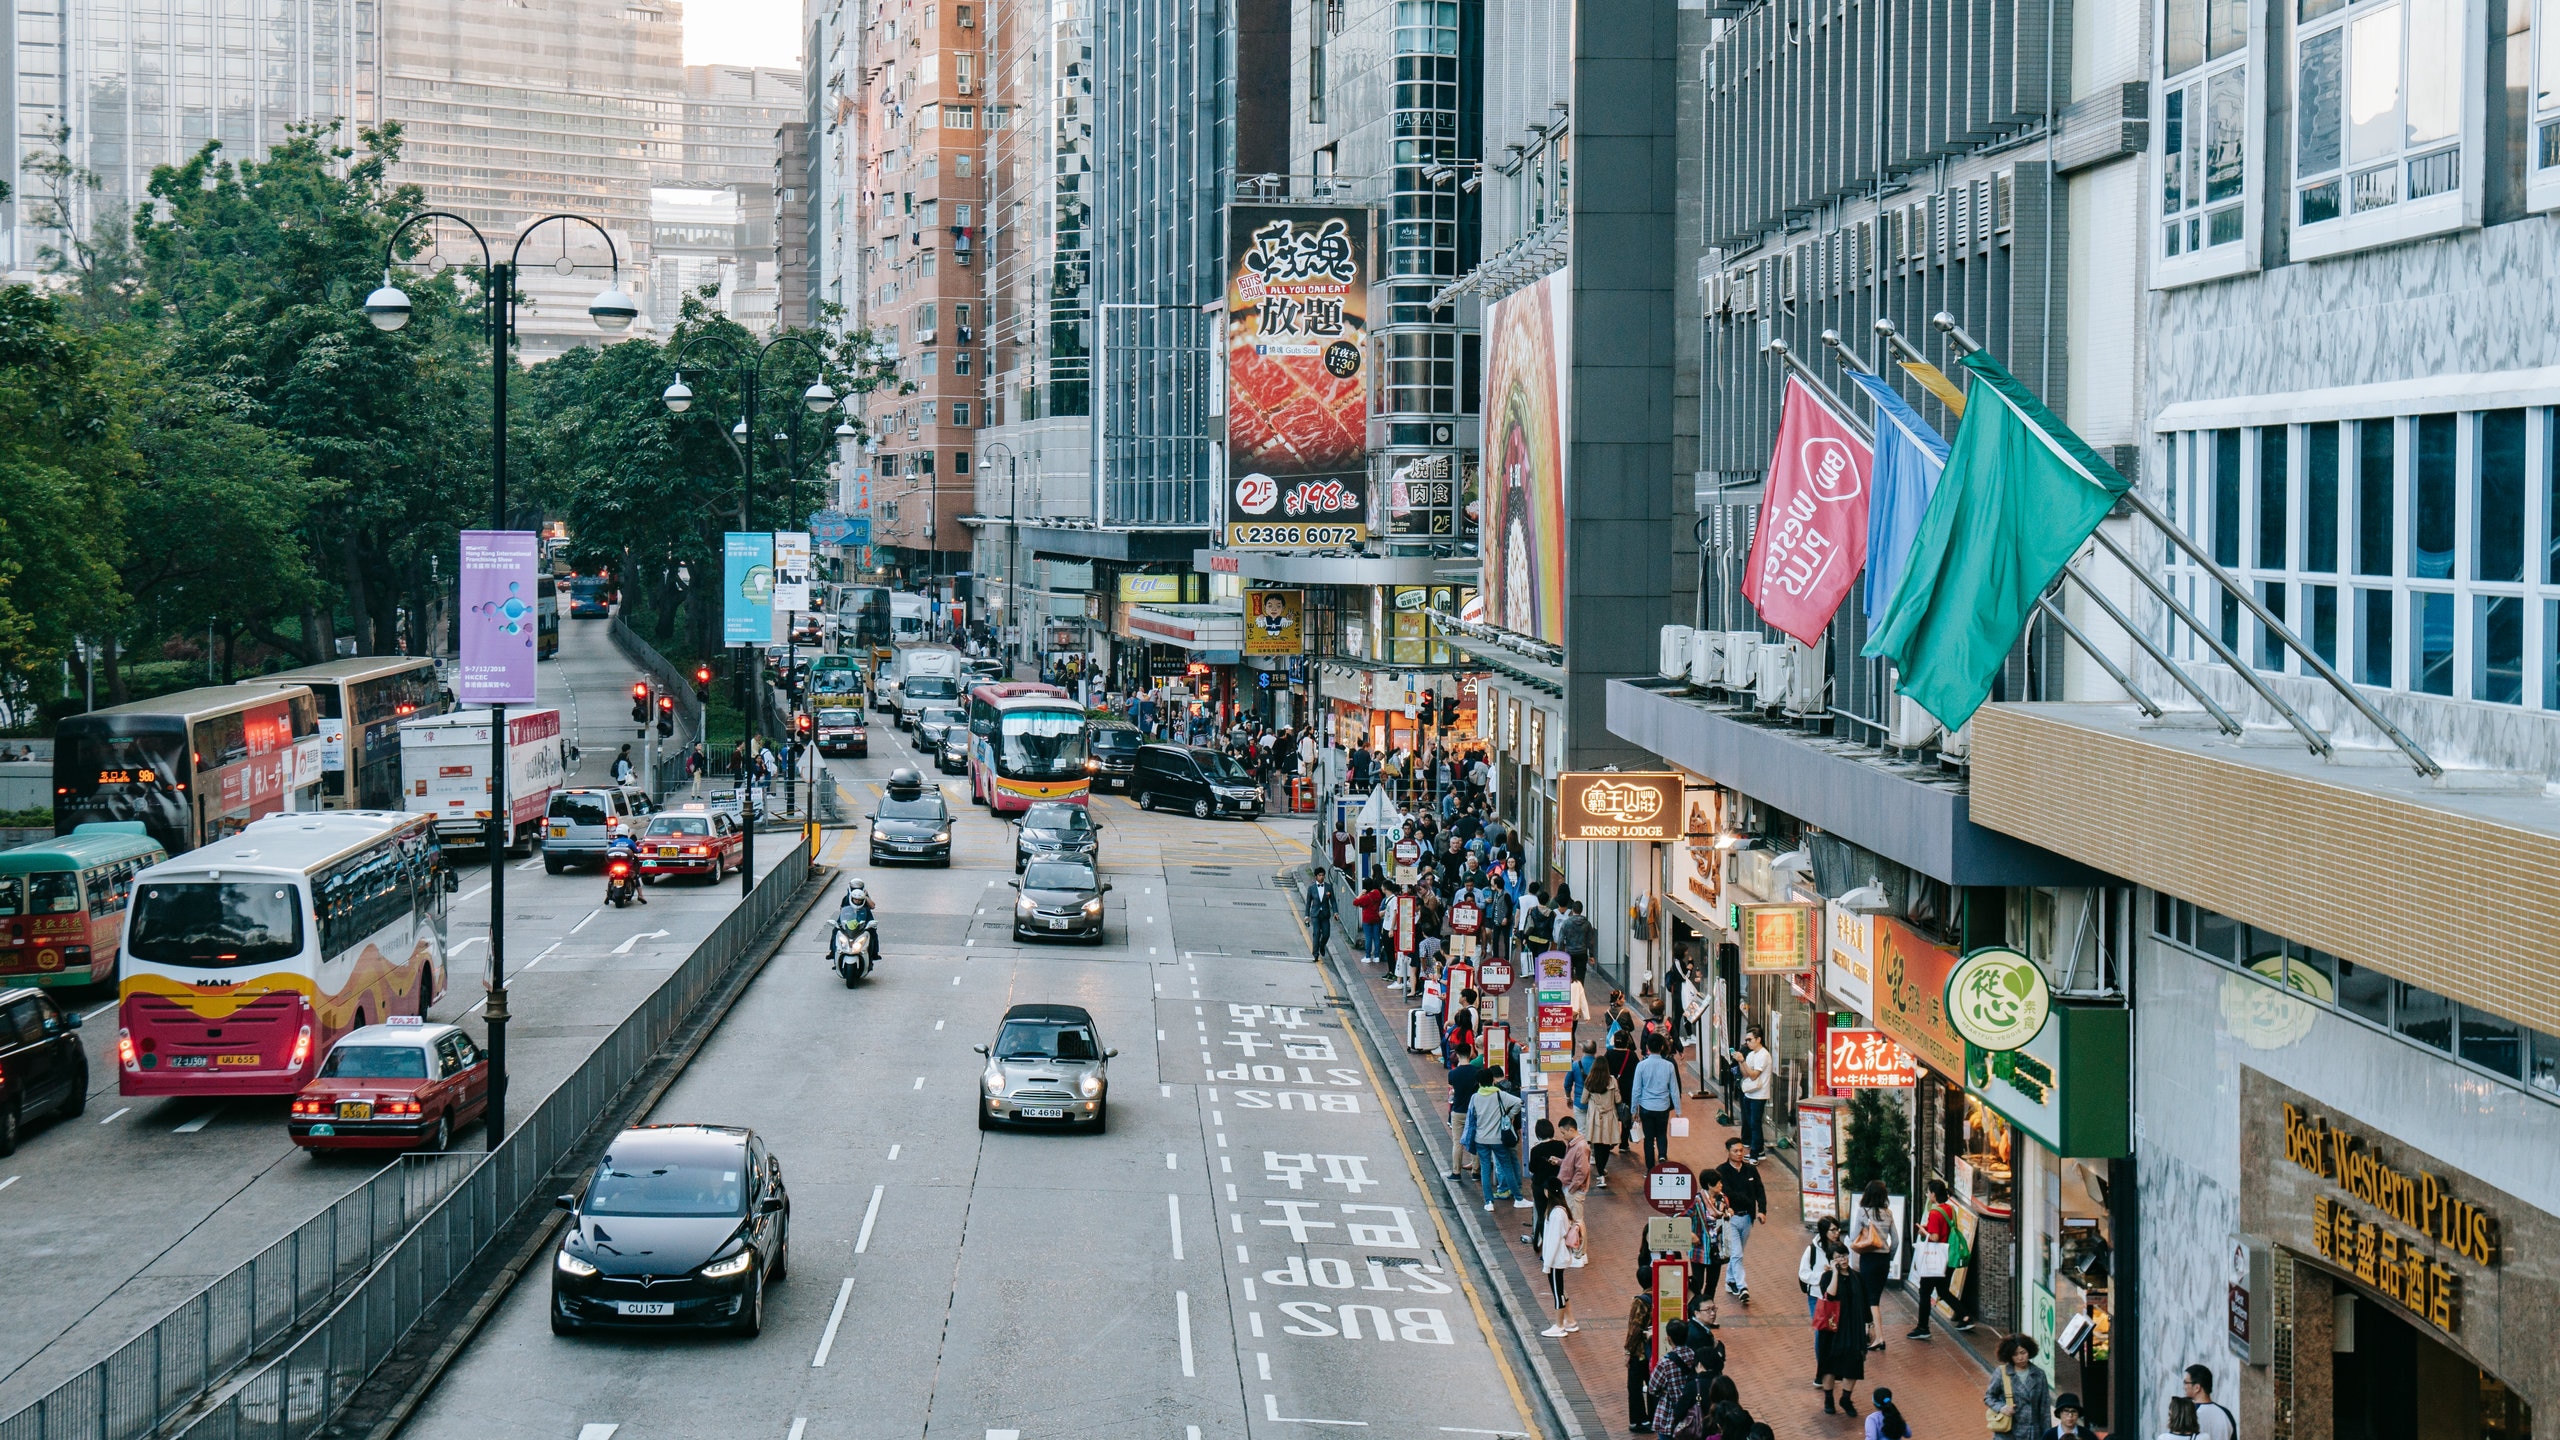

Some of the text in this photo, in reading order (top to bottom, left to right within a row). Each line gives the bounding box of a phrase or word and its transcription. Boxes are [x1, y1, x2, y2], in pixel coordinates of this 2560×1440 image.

[1238, 275, 1261, 288] GUTS
[1241, 286, 1264, 299] SOUL
[1270, 285, 1346, 294] ALL YOU CAN EAT
[1258, 297, 1344, 336] 放題
[1286, 346, 1301, 354] Guts
[1302, 346, 1318, 354] Soul
[1329, 356, 1355, 370] 1:30
[1242, 481, 1273, 507] 2/F
[1249, 527, 1357, 544] 2366 6072
[1392, 829, 1401, 841] 8
[1580, 825, 1664, 837] KINGS' LODGE
[1755, 954, 1785, 963] Uncle
[1497, 967, 1508, 975] 110
[197, 979, 231, 987] MAN
[389, 1017, 420, 1025] TAXI
[2023, 1000, 2037, 1031] 素食
[1961, 1021, 2023, 1041] HEARTFUL VEGGIE
[237, 1055, 255, 1063] 655
[1216, 1062, 1363, 1087] STOP
[1235, 1089, 1361, 1114] BUS
[1023, 1108, 1061, 1117] NC 4698
[2282, 1101, 2326, 1178] Best
[2331, 1126, 2418, 1230] Western
[1658, 1175, 1686, 1186] 5 28
[1668, 1223, 1673, 1233] 5
[2312, 1193, 2453, 1333] 最佳盛品酒店
[1261, 1256, 1454, 1295] STOP
[628, 1303, 664, 1314] CU 137
[1278, 1302, 1455, 1345] BUS
